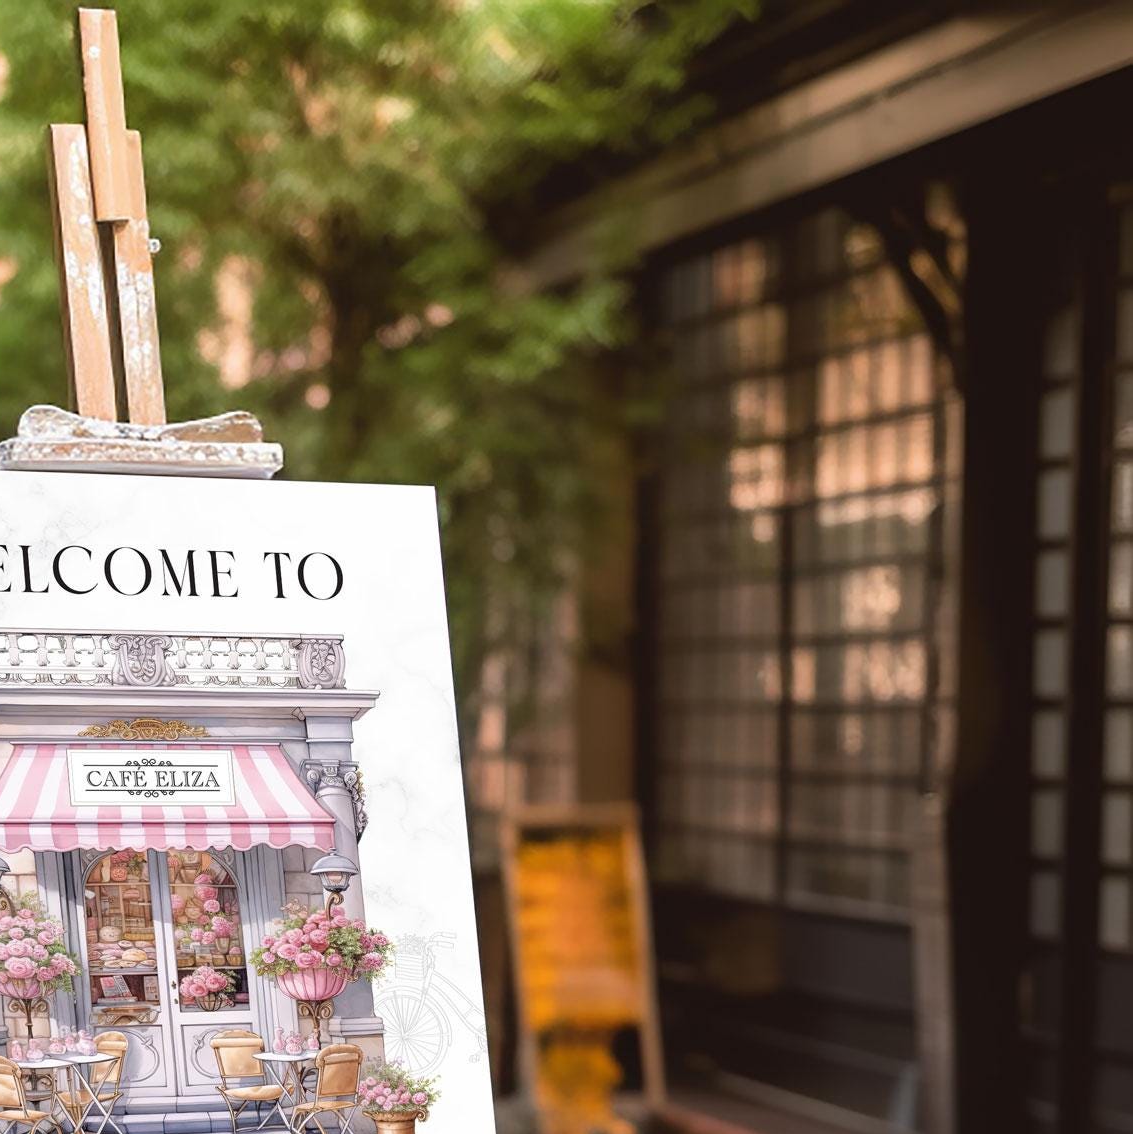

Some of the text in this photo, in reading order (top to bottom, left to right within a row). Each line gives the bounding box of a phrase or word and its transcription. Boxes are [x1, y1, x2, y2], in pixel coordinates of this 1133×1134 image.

[263, 552, 344, 600] TO
[85, 766, 221, 788] CAFÉ ELIZA
